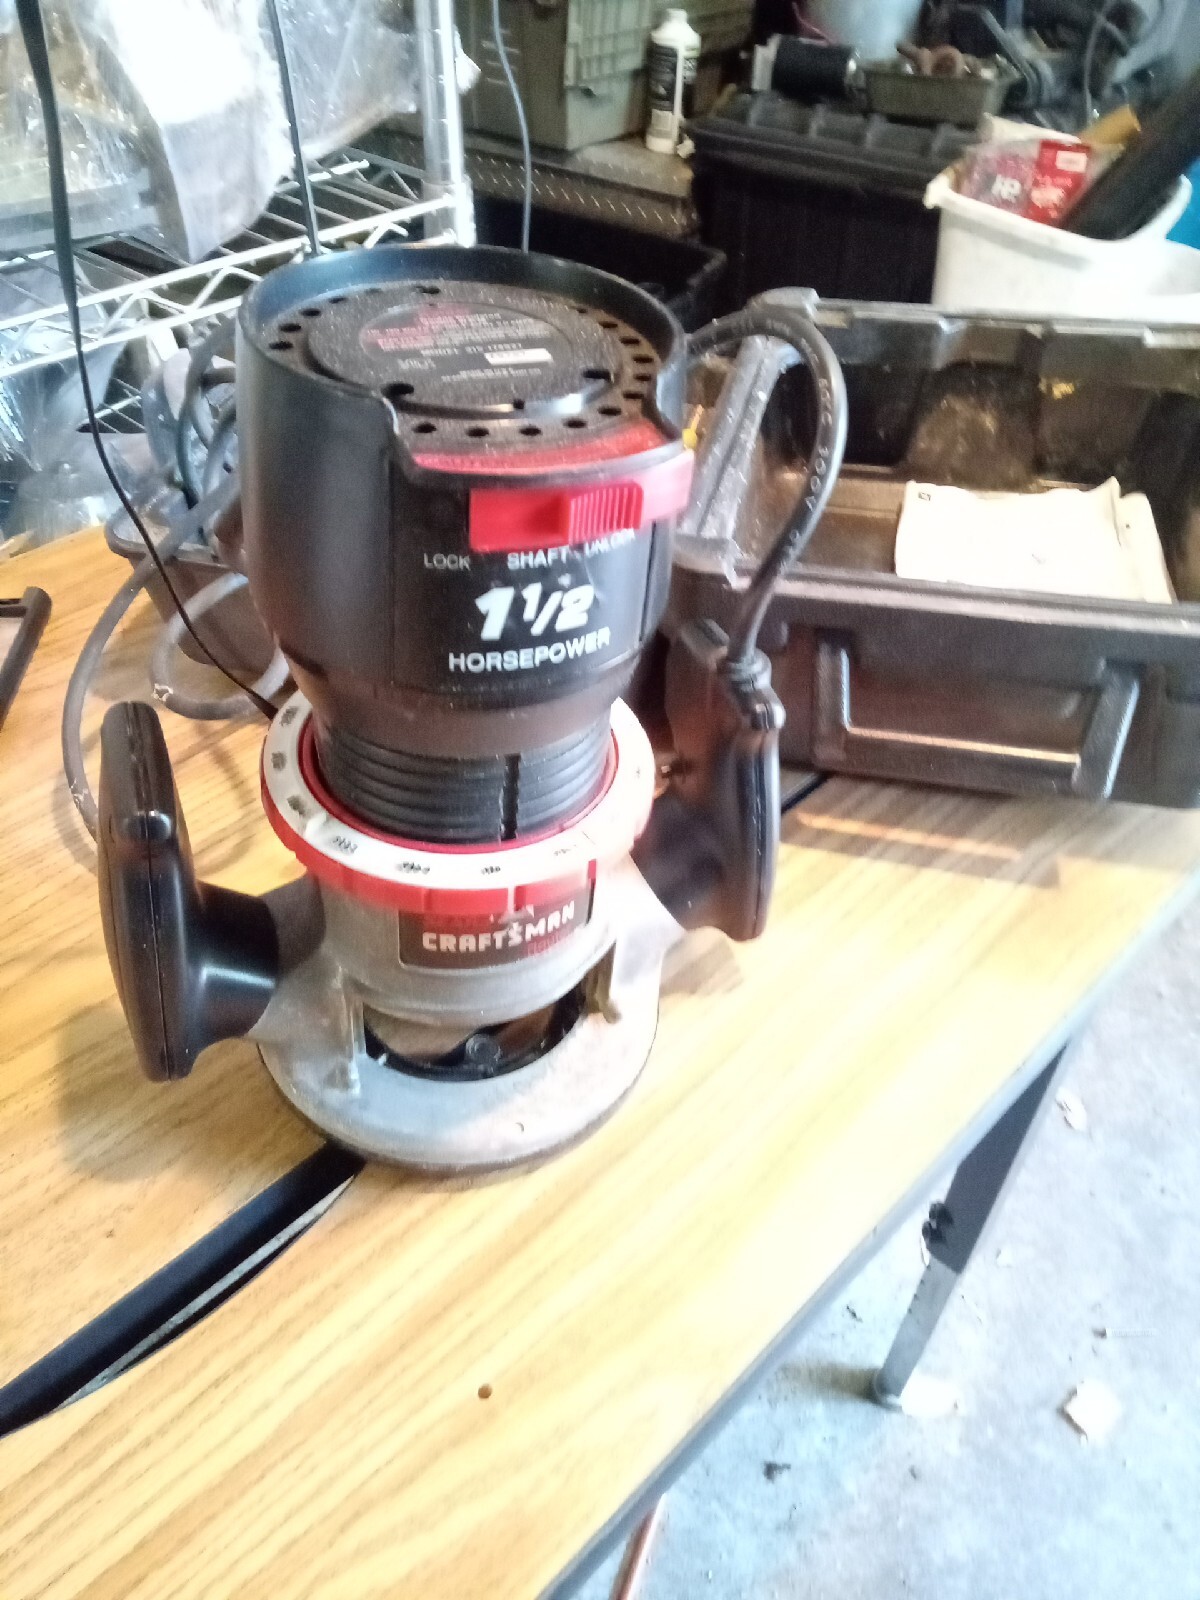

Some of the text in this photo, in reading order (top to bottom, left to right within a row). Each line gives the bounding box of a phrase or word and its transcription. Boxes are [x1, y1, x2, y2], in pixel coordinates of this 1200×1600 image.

[423, 553, 471, 571] LOCK
[507, 546, 569, 570] SHAFT
[448, 626, 611, 673] HORSEPOWER
[421, 899, 576, 954] CRAFTSMAN
